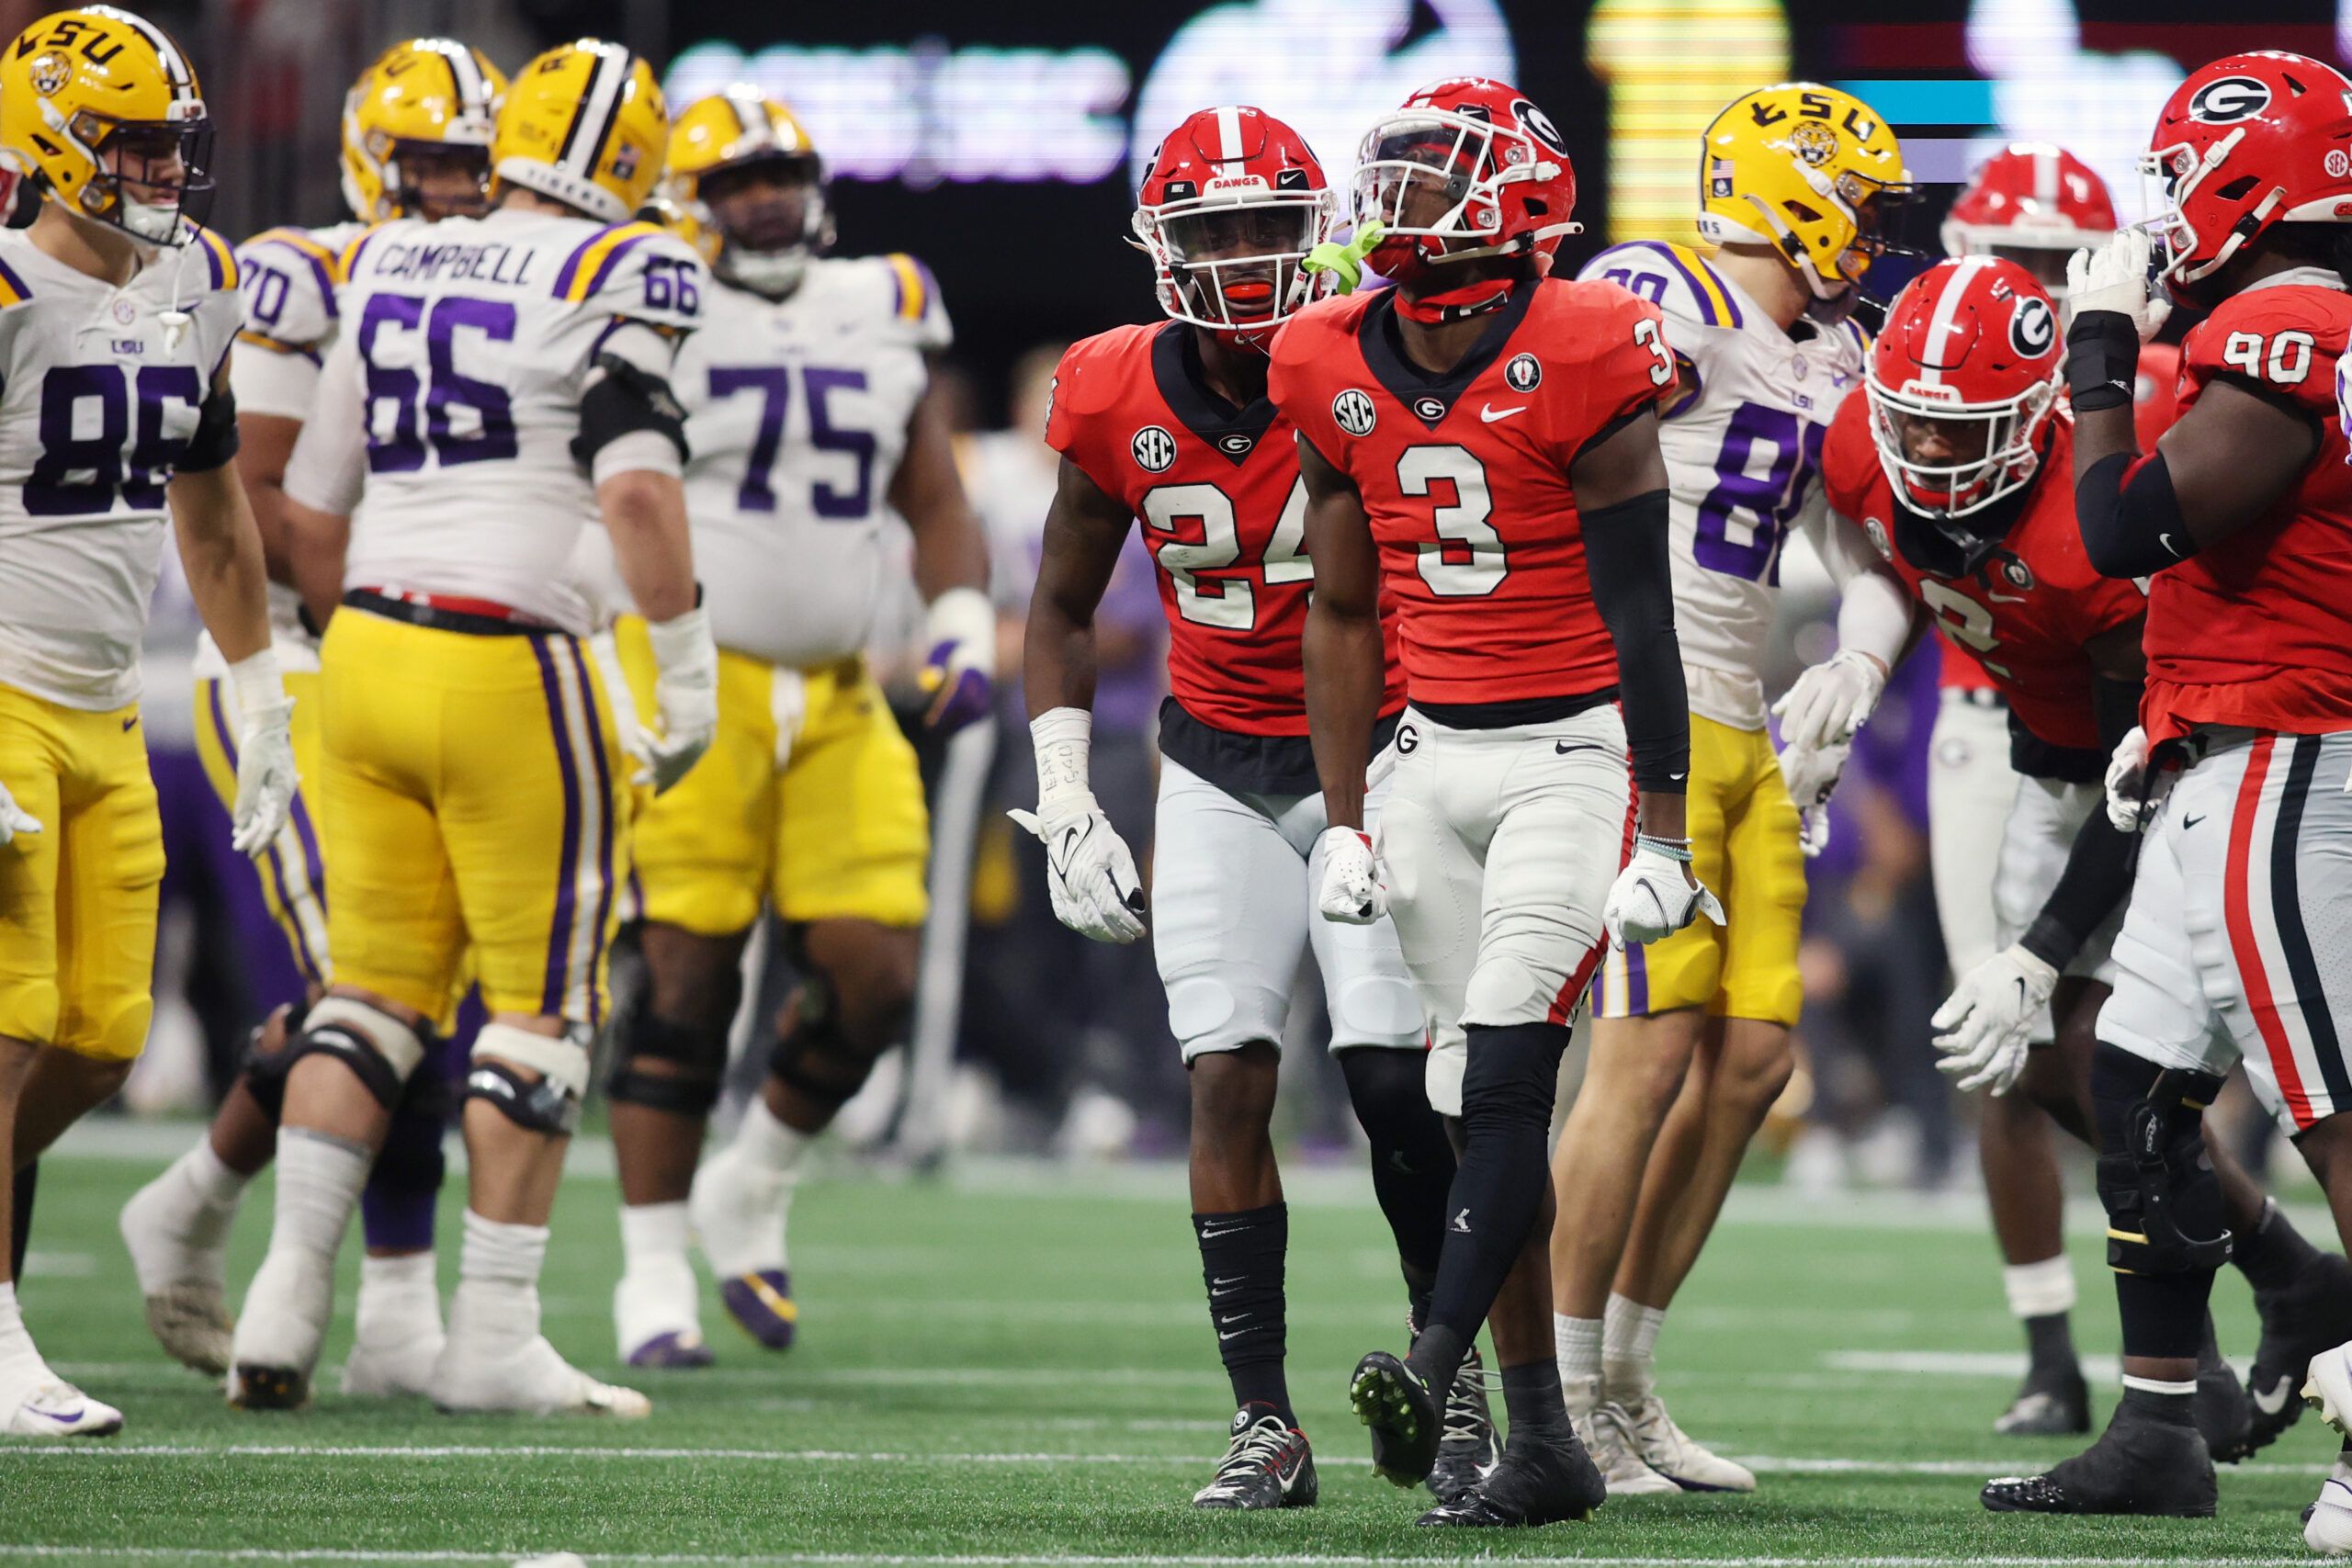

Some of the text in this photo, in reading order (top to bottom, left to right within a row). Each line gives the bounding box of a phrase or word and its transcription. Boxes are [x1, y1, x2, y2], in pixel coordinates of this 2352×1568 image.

[2328, 152, 2346, 174] SEC
[1170, 184, 1185, 193] NIKE
[1214, 177, 1260, 189] DAWGS
[375, 243, 536, 286] CAMPBELL
[643, 253, 698, 317] 66
[110, 339, 144, 355] LSU
[2011, 299, 2054, 357] G
[1634, 319, 1673, 386] 3
[2222, 329, 2315, 384] 90
[359, 293, 518, 473] 66
[1908, 386, 1951, 400] DAWGS
[1335, 394, 1374, 433] SEC
[1416, 399, 1444, 419] G
[707, 367, 877, 518] 75
[1135, 430, 1172, 469] SEC
[1220, 436, 1251, 452] G
[1396, 445, 1510, 596] 3
[1396, 725, 1419, 754] G
